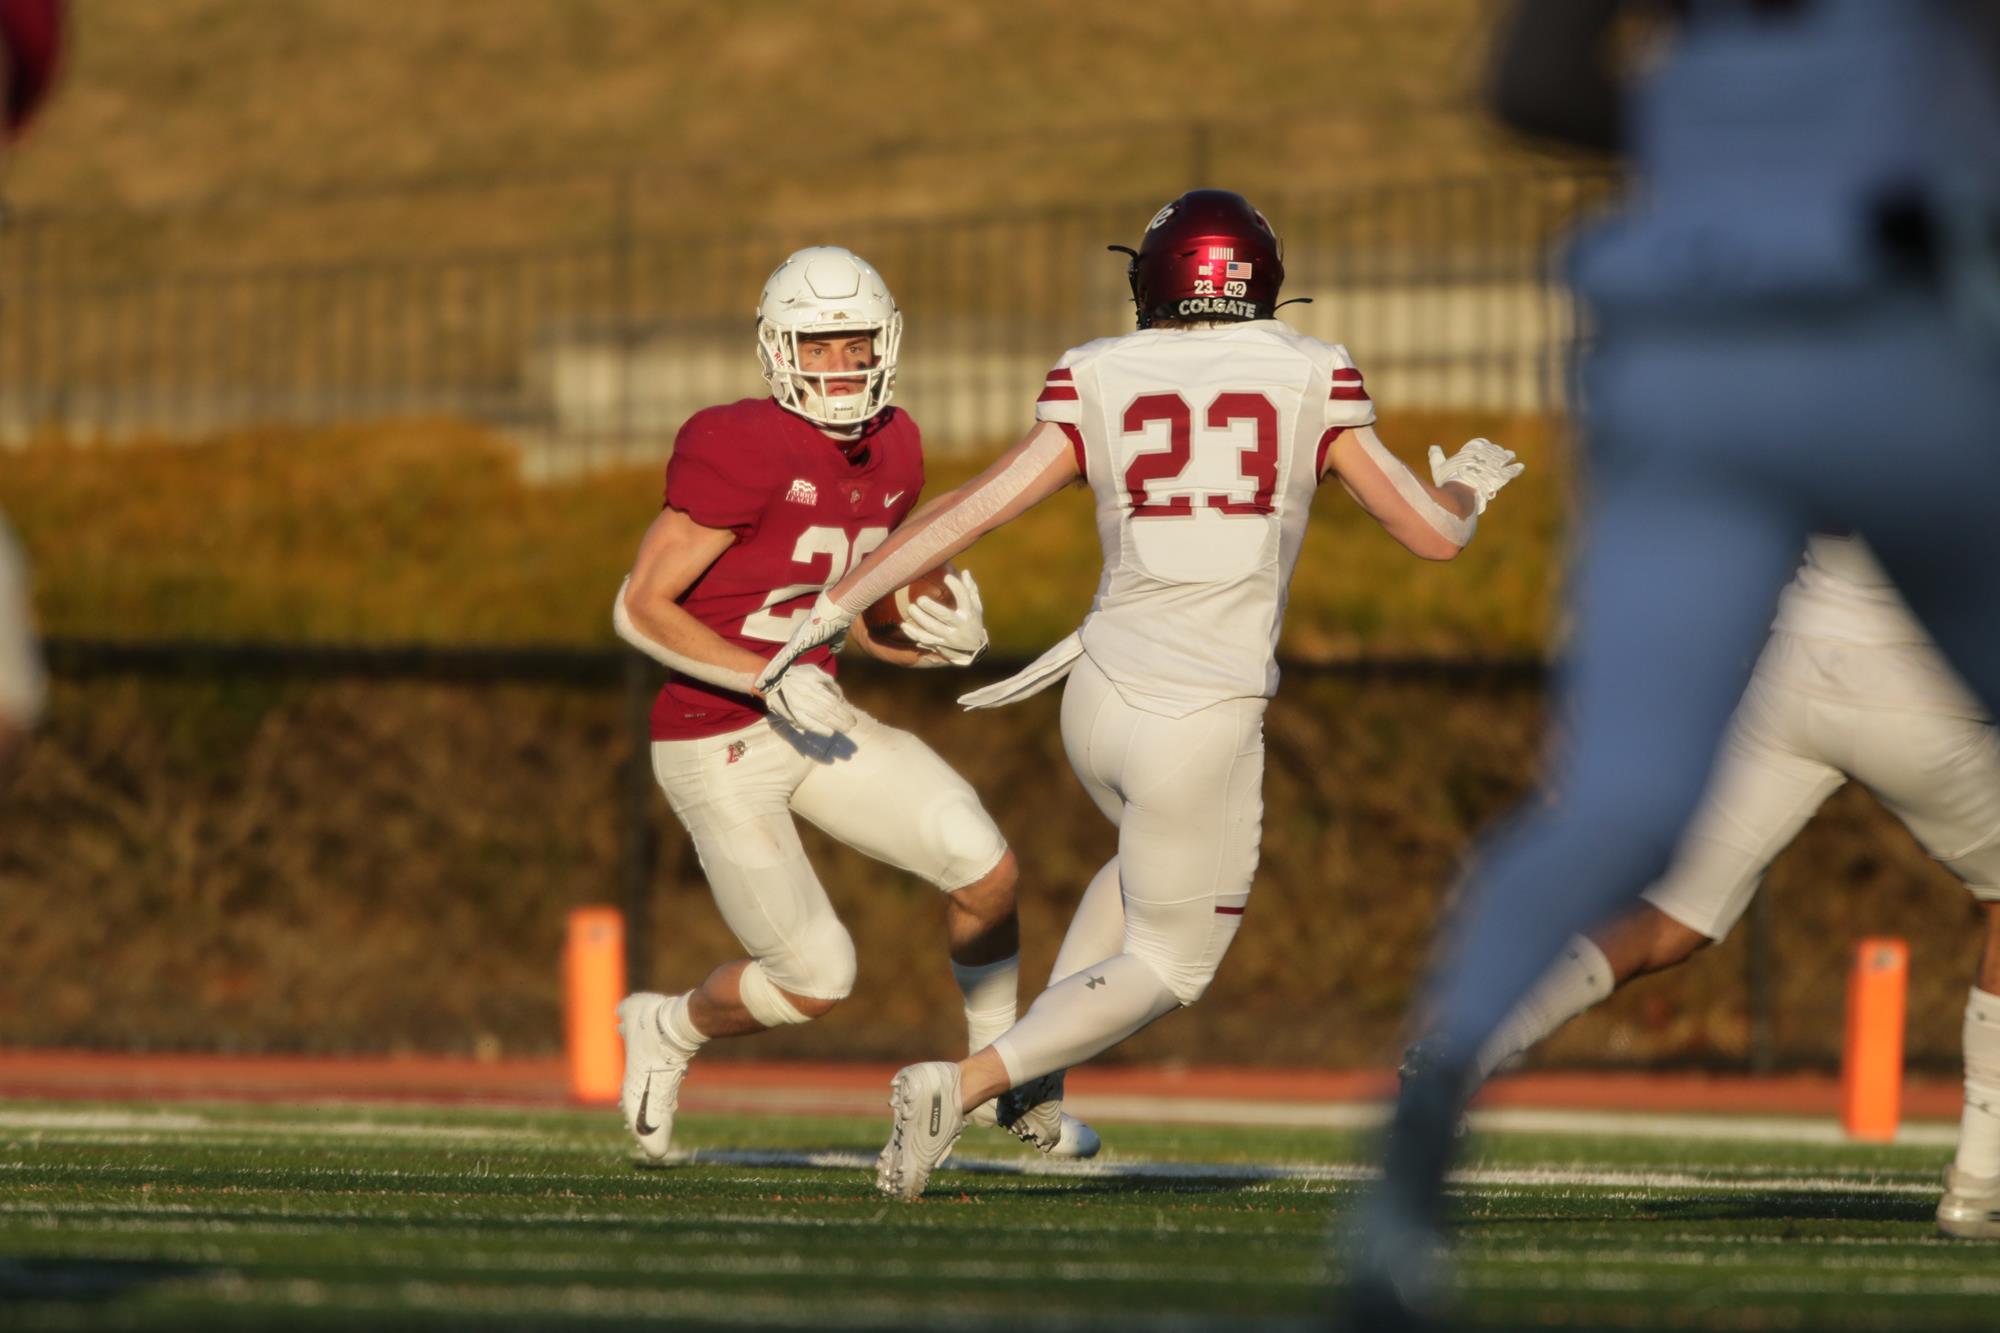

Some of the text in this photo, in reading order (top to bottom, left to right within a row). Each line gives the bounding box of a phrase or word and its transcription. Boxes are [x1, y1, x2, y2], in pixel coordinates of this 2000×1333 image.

[1194, 280, 1244, 296] 23 42
[1178, 298, 1256, 319] COLGATE
[1121, 390, 1280, 520] 23
